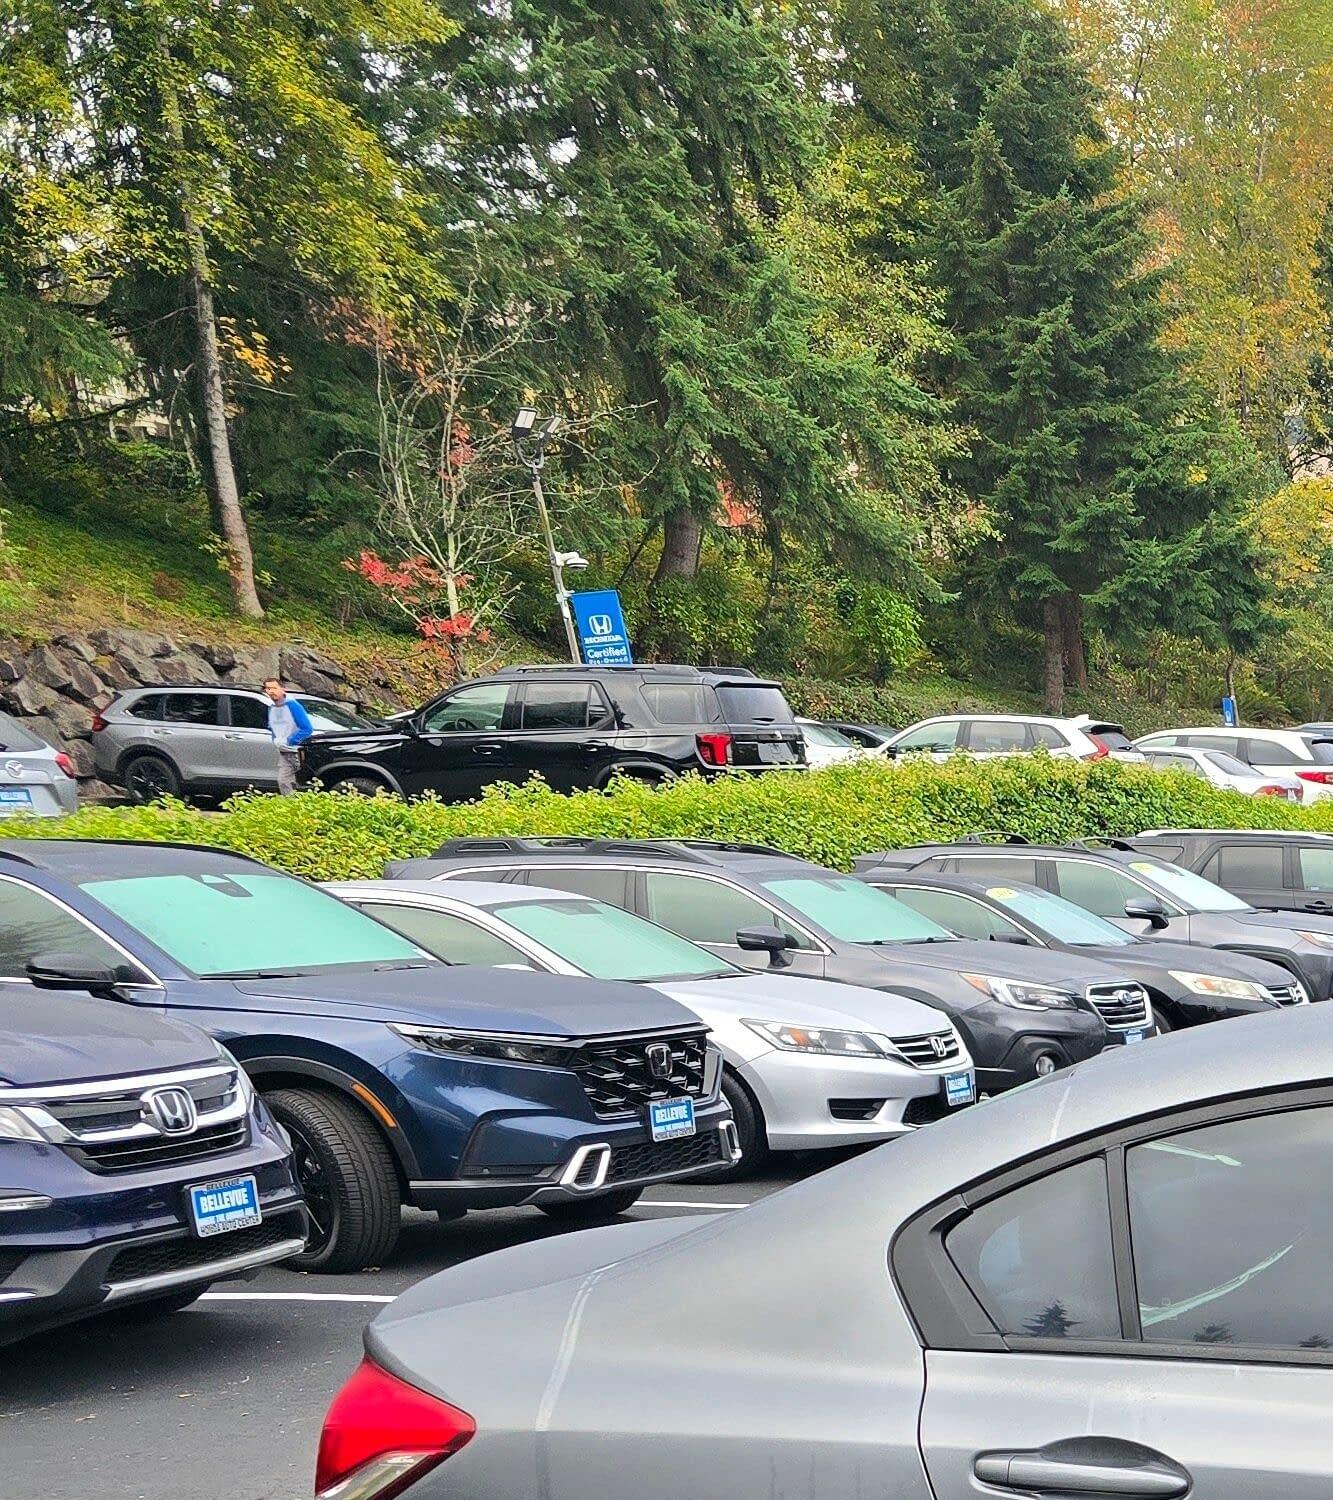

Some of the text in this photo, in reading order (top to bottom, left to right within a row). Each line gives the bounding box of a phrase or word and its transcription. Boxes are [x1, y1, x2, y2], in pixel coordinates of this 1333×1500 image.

[584, 635, 624, 644] HONDA
[587, 646, 627, 659] Certified
[655, 1105, 689, 1123] BELLEVUE
[200, 1188, 249, 1214] BELLEVUE
